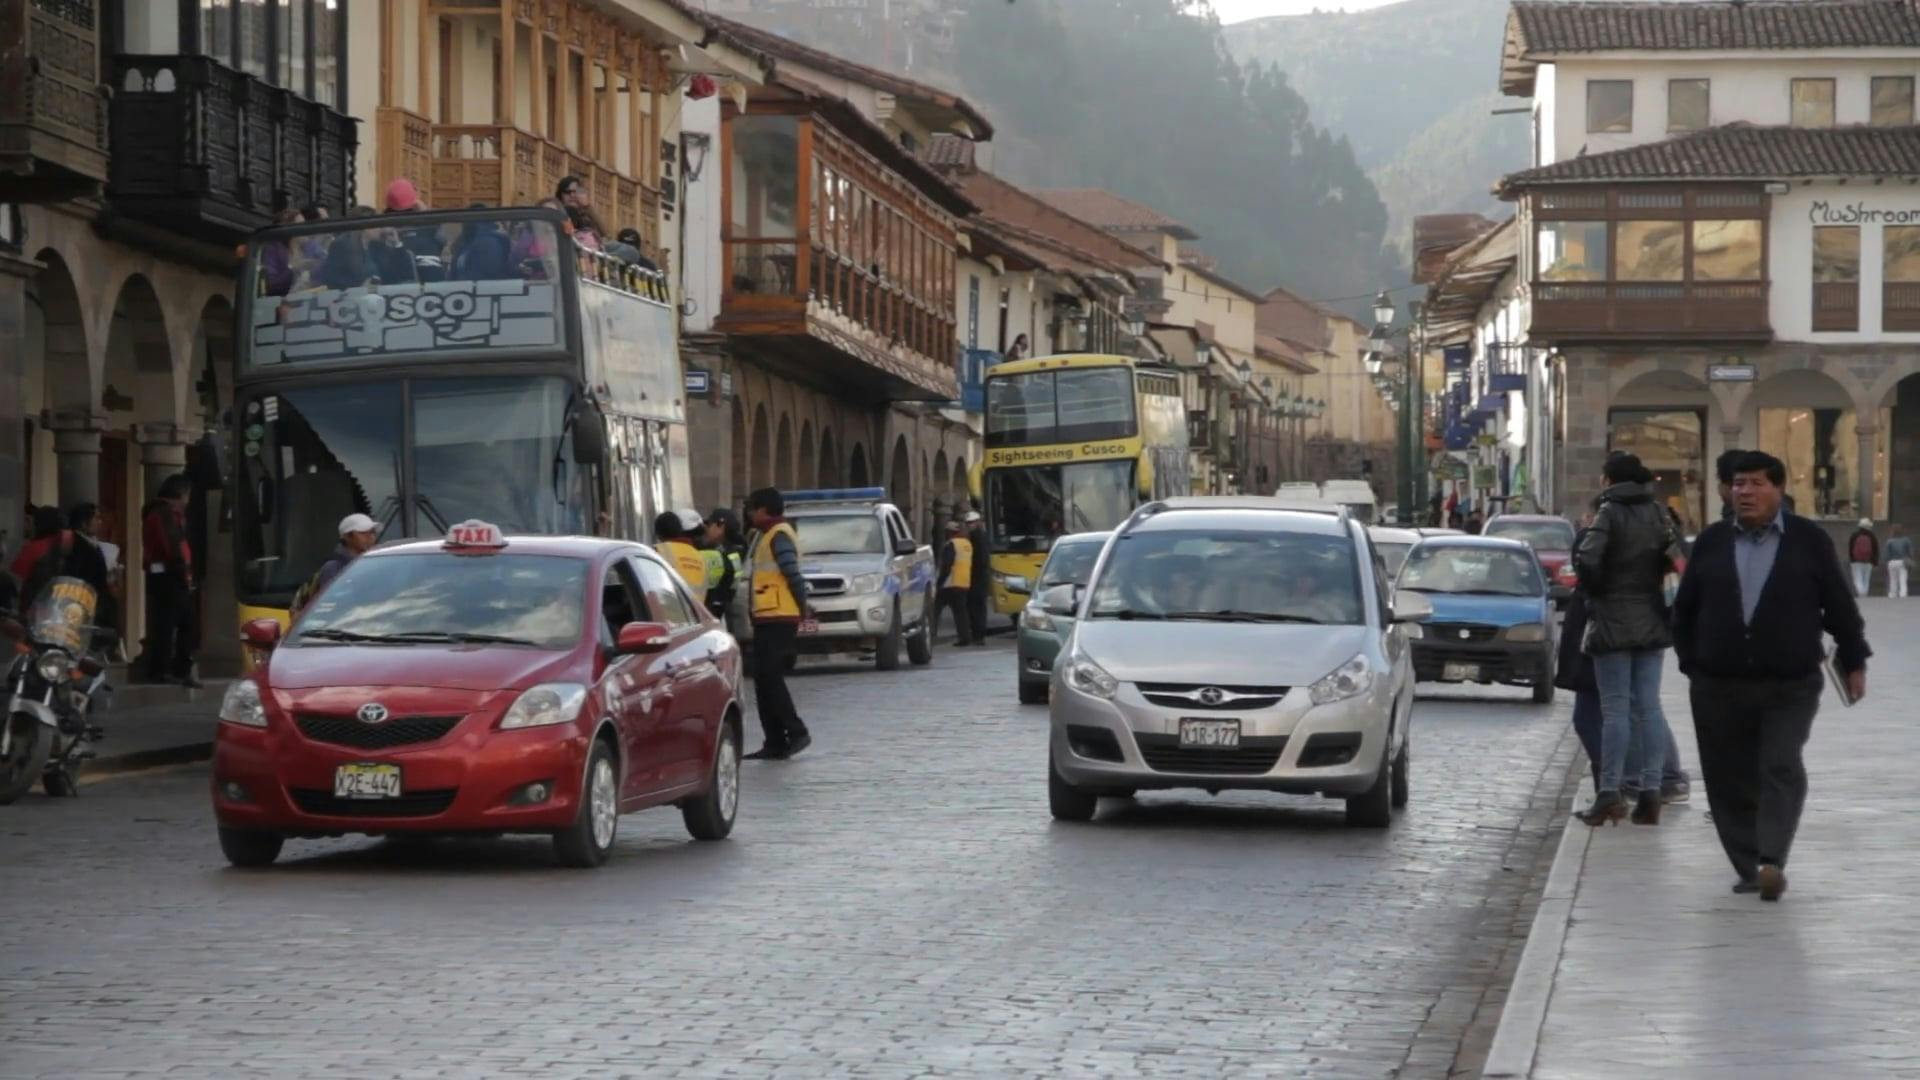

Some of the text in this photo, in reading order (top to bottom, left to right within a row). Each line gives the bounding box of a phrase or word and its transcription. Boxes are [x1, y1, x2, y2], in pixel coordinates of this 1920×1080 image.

[991, 444, 1126, 464] Sightseeing Cusco
[453, 528, 492, 543] TAXI
